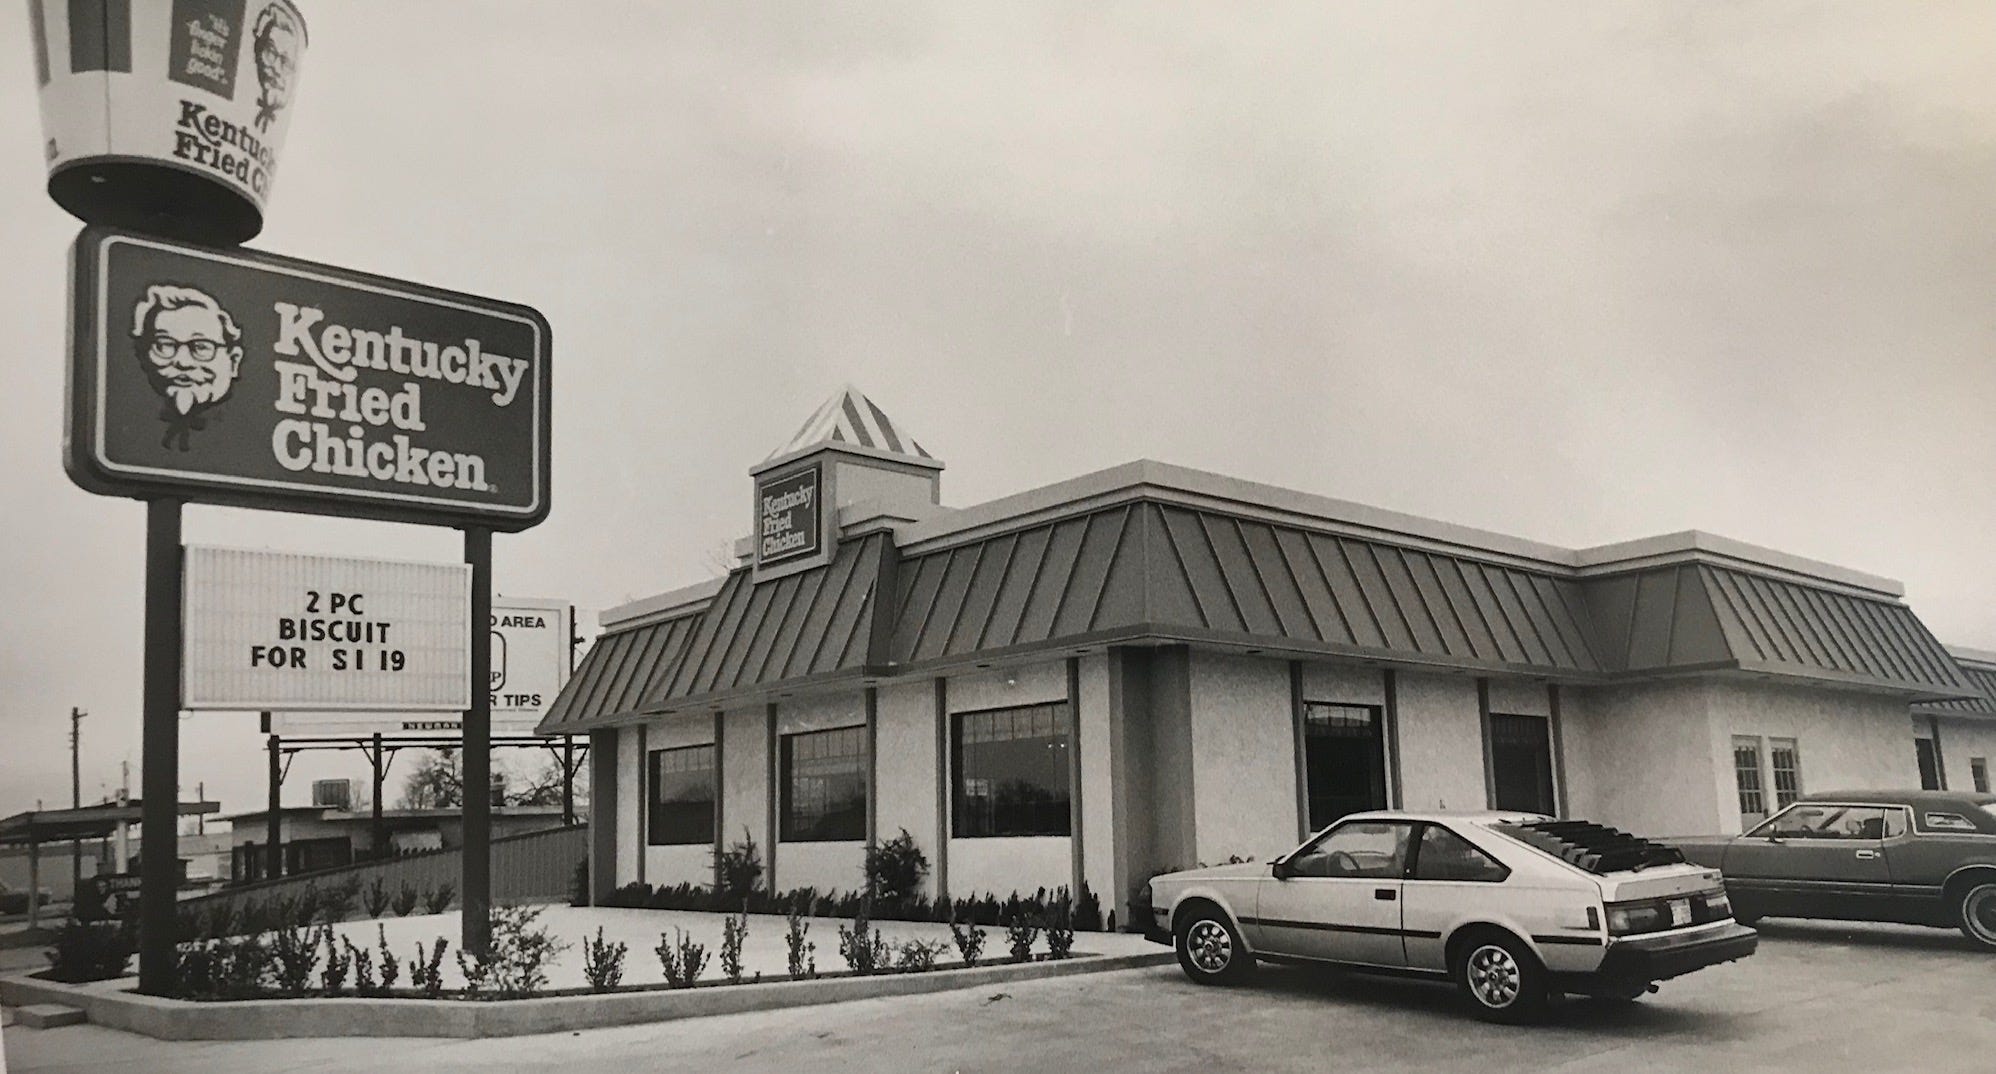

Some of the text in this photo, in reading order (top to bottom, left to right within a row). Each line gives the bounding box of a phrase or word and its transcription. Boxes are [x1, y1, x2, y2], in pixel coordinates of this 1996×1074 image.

[173, 130, 249, 185] Fried
[273, 301, 529, 407] Kentucky
[273, 360, 426, 432] Fried
[272, 418, 489, 492] Chicken
[762, 485, 814, 518] Kentucky
[762, 510, 792, 536] Fried
[762, 531, 805, 556] Chicken
[306, 591, 364, 615] 2 PC
[279, 618, 391, 643] BISCUIT
[501, 616, 546, 629] AREA
[251, 646, 307, 669] FOR
[503, 694, 542, 706] TIPS
